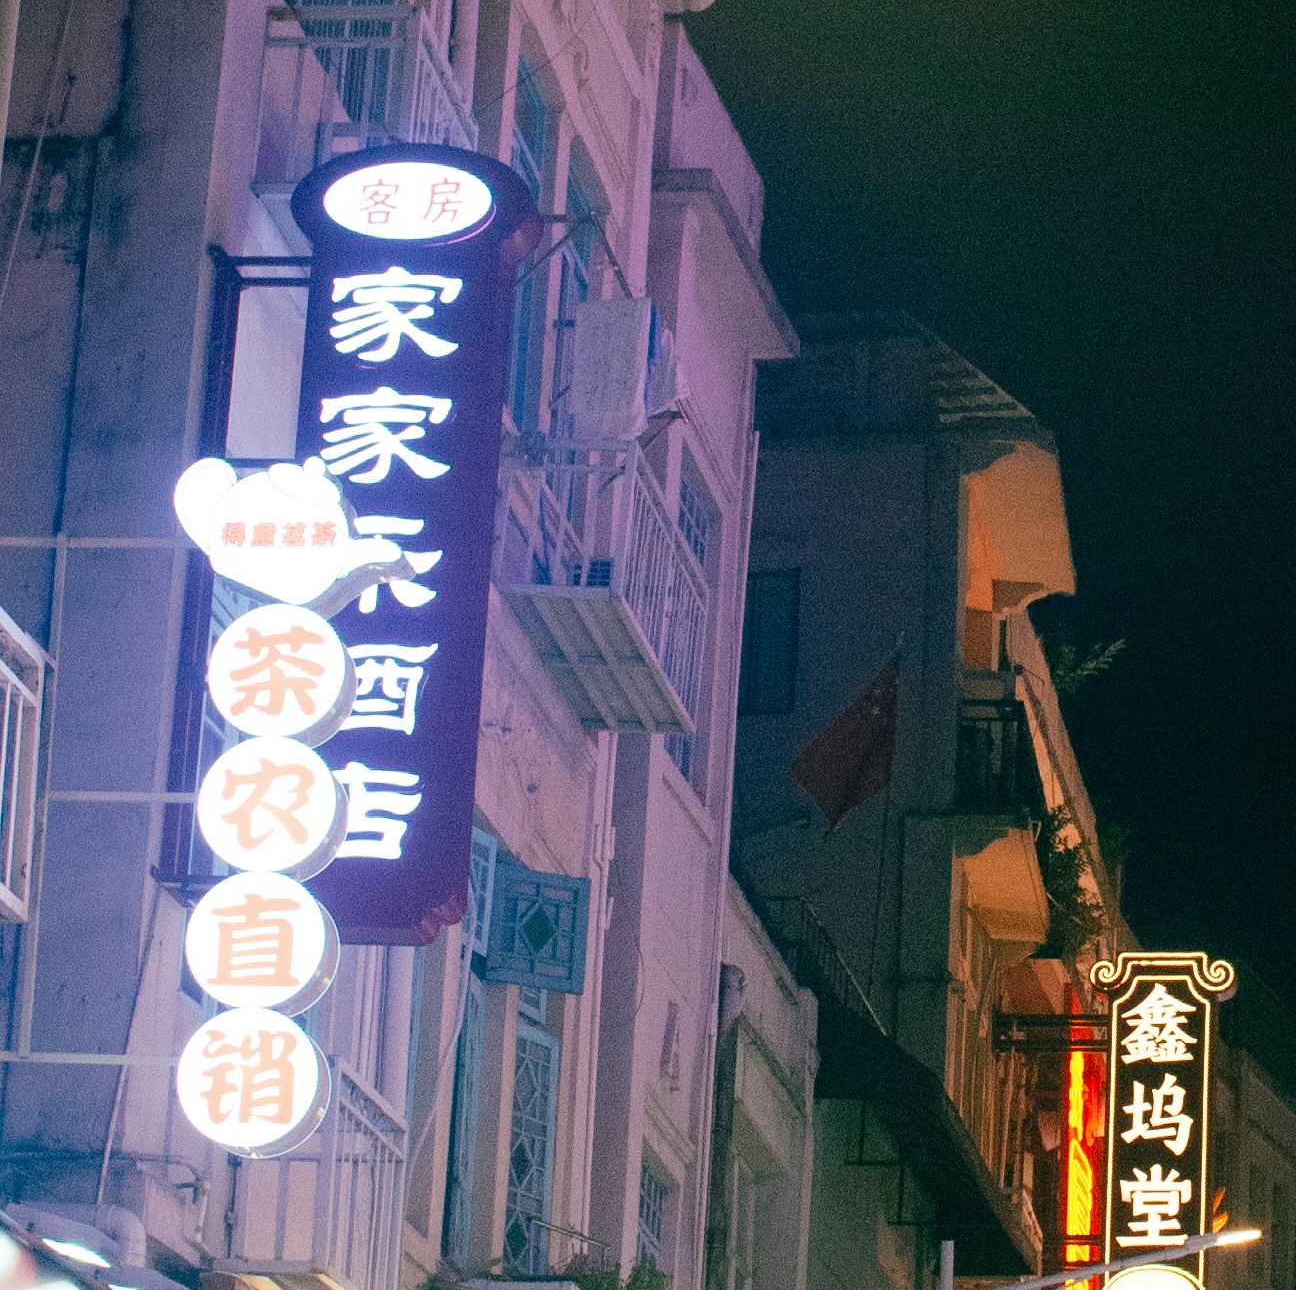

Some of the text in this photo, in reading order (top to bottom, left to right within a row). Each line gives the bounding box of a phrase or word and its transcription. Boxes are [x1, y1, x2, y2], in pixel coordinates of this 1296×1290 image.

[357, 176, 463, 230] 客房
[221, 520, 338, 548] 得意茗茶
[200, 623, 327, 1128] 茶农直销
[1116, 982, 1198, 1249] 鑫坞堂
